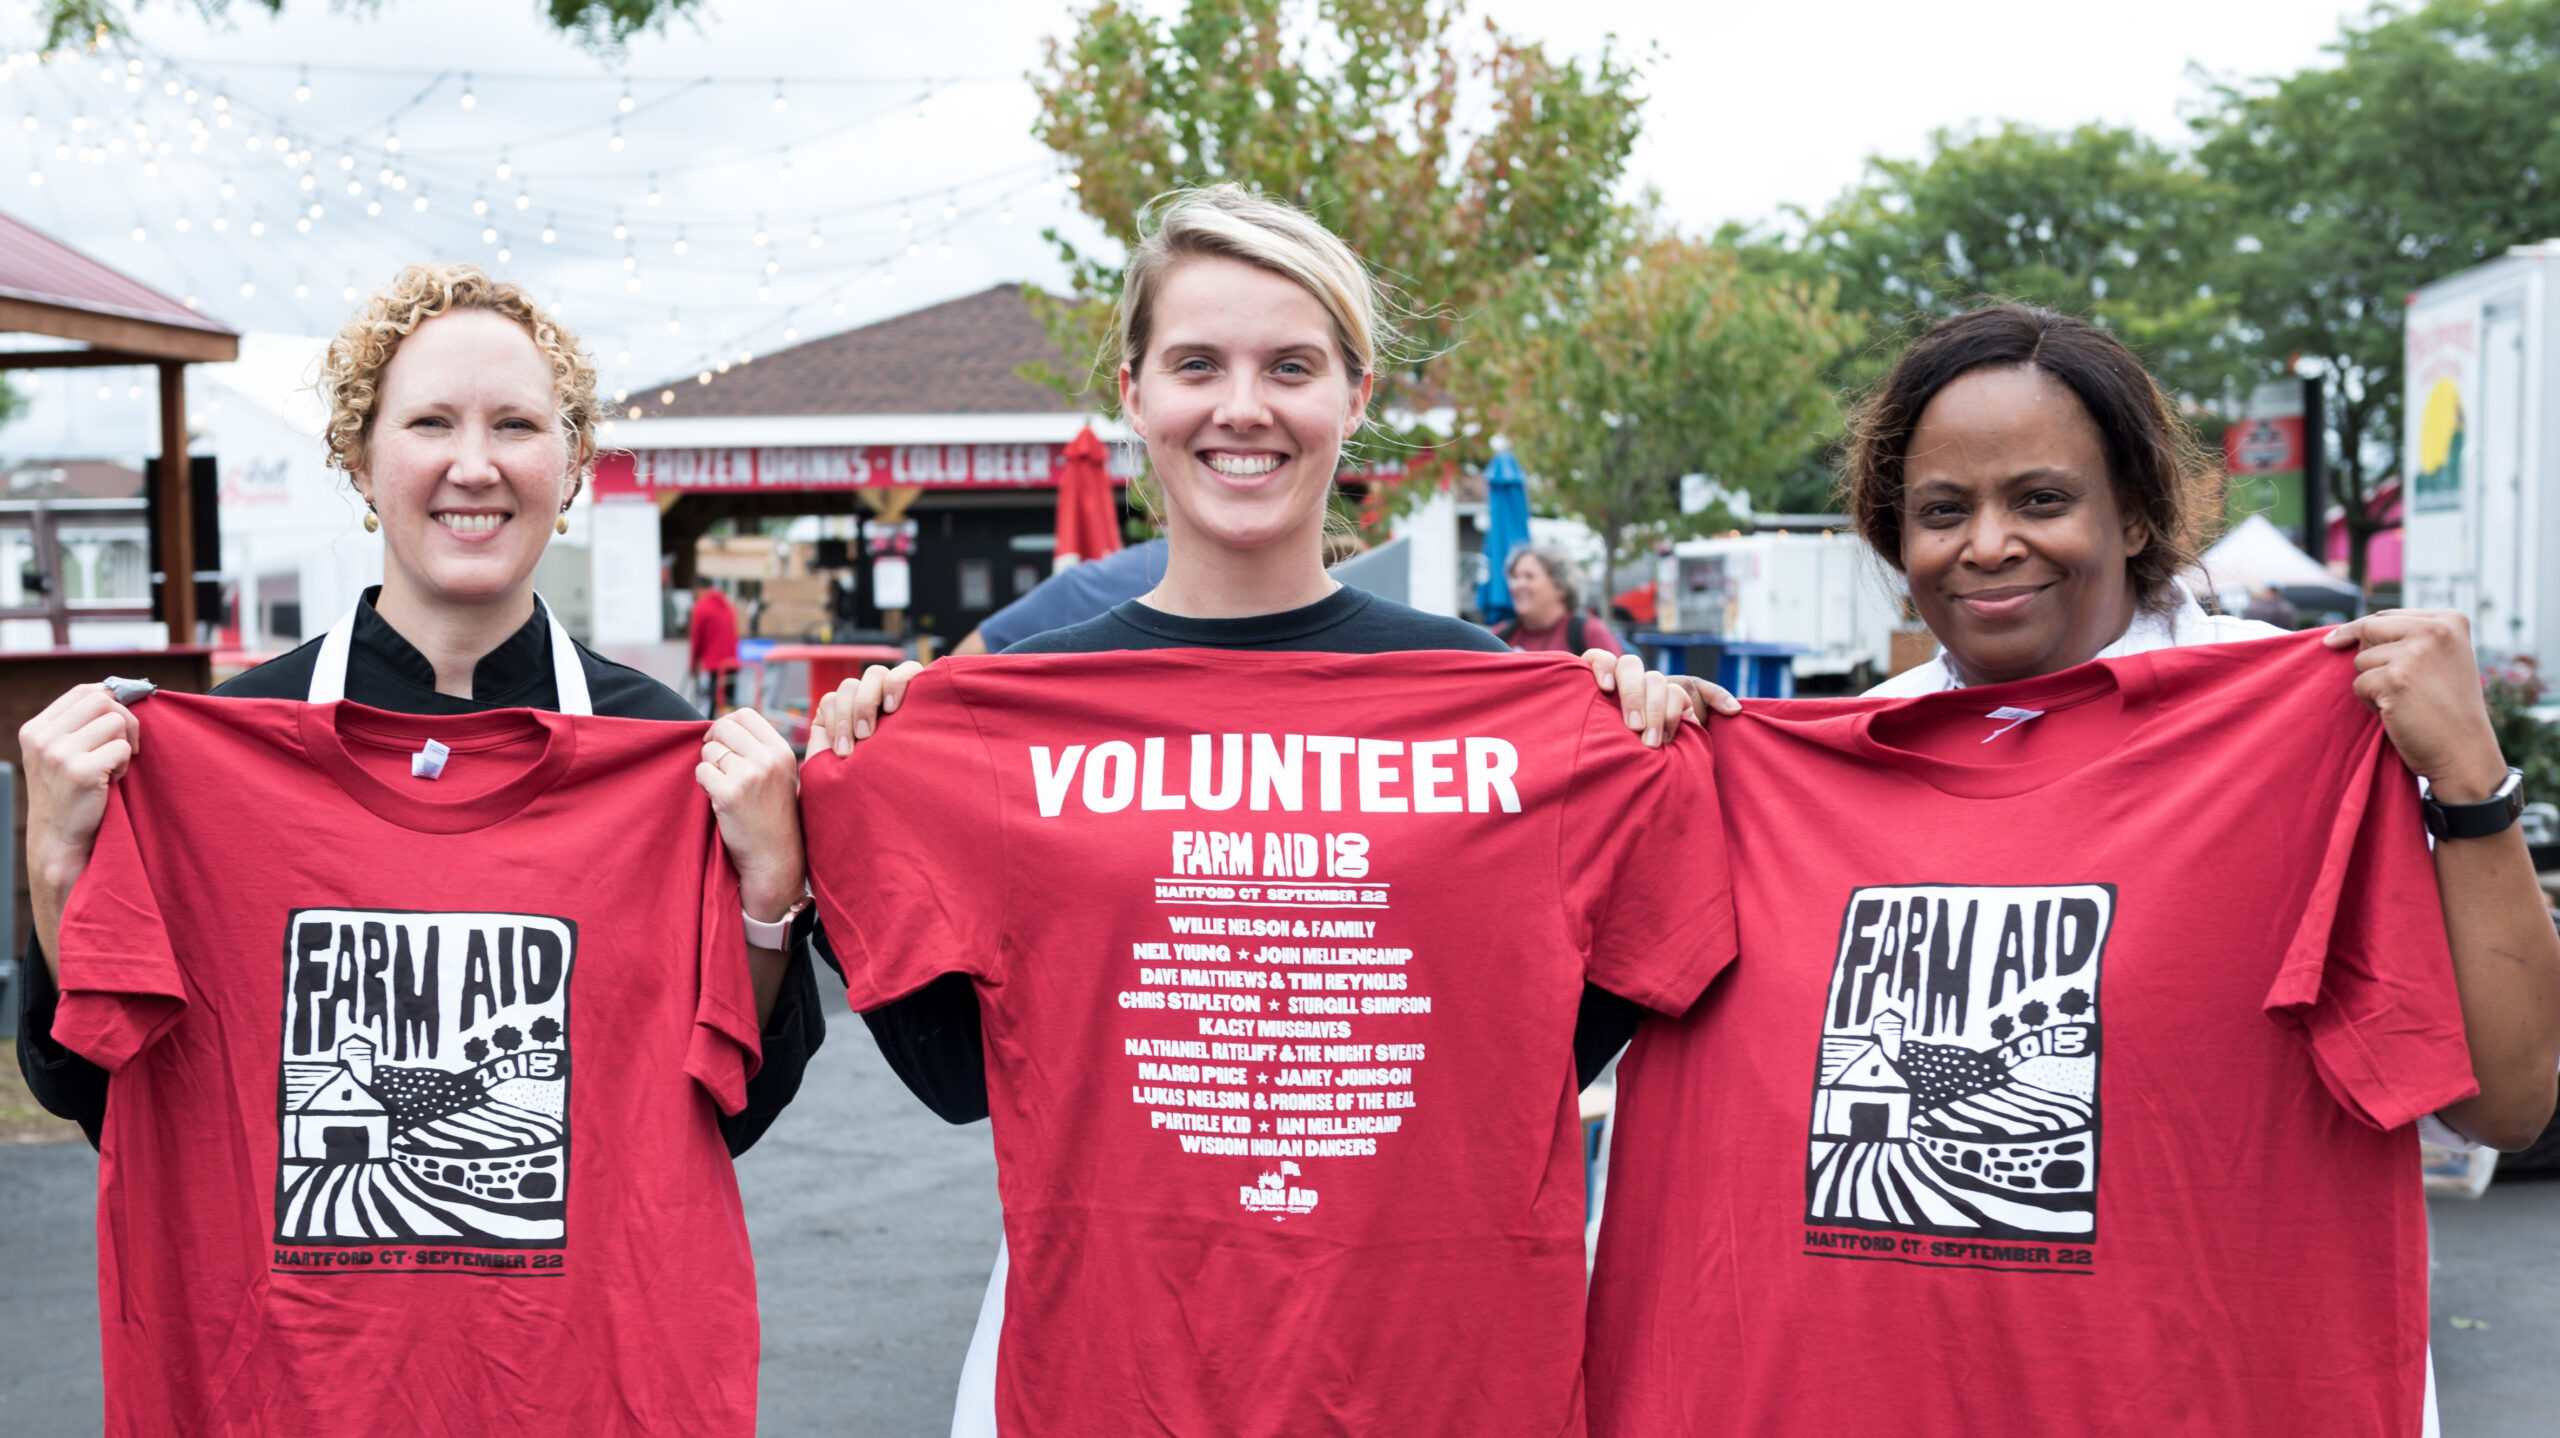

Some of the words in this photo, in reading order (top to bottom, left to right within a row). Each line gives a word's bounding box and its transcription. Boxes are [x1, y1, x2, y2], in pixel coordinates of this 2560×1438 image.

[636, 448, 752, 487] FROZEN
[758, 447, 871, 487] DRINKS
[892, 445, 968, 483] COLD
[973, 444, 1049, 483] BEER
[1029, 733, 1521, 817] VOLUNTEER
[1172, 831, 1253, 875] FARM
[1263, 832, 1319, 877] AID
[1156, 886, 1235, 899] HARTFORD
[1239, 888, 1261, 900] CT
[1267, 888, 1357, 902] SEPTEMBER
[1361, 890, 1387, 902] 22
[1168, 917, 1226, 935] WILLIE
[1228, 919, 1289, 937] NELSON
[1292, 920, 1309, 937] &
[1312, 921, 1376, 938] FAMILY
[1133, 943, 1171, 960] NEIL
[1173, 944, 1230, 962] YOUNG
[1254, 946, 1300, 964] JOHN
[1303, 948, 1413, 965] MELLENCAMP
[1834, 896, 1979, 1037] FARM
[1989, 897, 2099, 1008] AID
[1141, 968, 1179, 985] DAVE
[1181, 969, 1267, 989] MATTHEWS
[1269, 972, 1285, 989] &
[1287, 973, 1323, 990] TIM
[1325, 973, 1407, 990] REYNOLDS
[292, 922, 439, 1061] FARM
[459, 926, 563, 1034] AID
[1118, 991, 1165, 1009] CHRIS
[1167, 992, 1260, 1012] STAPLETON
[1288, 997, 1359, 1014] STURGILL
[1361, 997, 1431, 1014] SIMPSON
[1199, 1018, 1255, 1036] KACEY
[1257, 1020, 1351, 1038] MUSGRAVES
[1125, 1039, 1210, 1059] NATHANIEL
[1212, 1042, 1277, 1061] RATELIFF
[1295, 1045, 1322, 1062] THE
[1324, 1045, 1373, 1062] NIGHT
[1375, 1044, 1425, 1061] SWEATS
[1998, 1027, 2088, 1067] 2018
[475, 1053, 558, 1088] 2018
[1139, 1062, 1200, 1083] MARGO
[1202, 1066, 1247, 1085] PRICE
[1274, 1069, 1333, 1086] JAMEY
[1335, 1068, 1411, 1086] JOHNSON
[1133, 1086, 1185, 1106] LUKAS
[1187, 1090, 1249, 1109] NELSON
[1253, 1092, 1268, 1110] &
[1270, 1093, 1334, 1111] PROMISE
[1336, 1093, 1354, 1110] OF
[1356, 1093, 1384, 1109] THE
[1387, 1091, 1416, 1109] REAL
[1151, 1111, 1220, 1132] PARTICLE
[1222, 1116, 1251, 1133] KID
[1277, 1118, 1305, 1135] IAN
[1308, 1116, 1401, 1135] MELLENCAMP
[1179, 1135, 1248, 1155] WISDOM
[1251, 1139, 1302, 1156] INDIAN
[1305, 1138, 1376, 1156] DANCERS
[1240, 1186, 1286, 1205] FARM
[1288, 1187, 1318, 1205] AID
[274, 1249, 373, 1265] HARTFORD
[379, 1251, 406, 1264] CT
[415, 1251, 526, 1268] SEPTEMBER
[531, 1254, 564, 1268] 22
[1805, 1232, 1896, 1252] HARTFORD
[1901, 1239, 1920, 1255] CT
[1930, 1241, 2050, 1262] SEPTEMBER
[2057, 1249, 2092, 1264] 22
